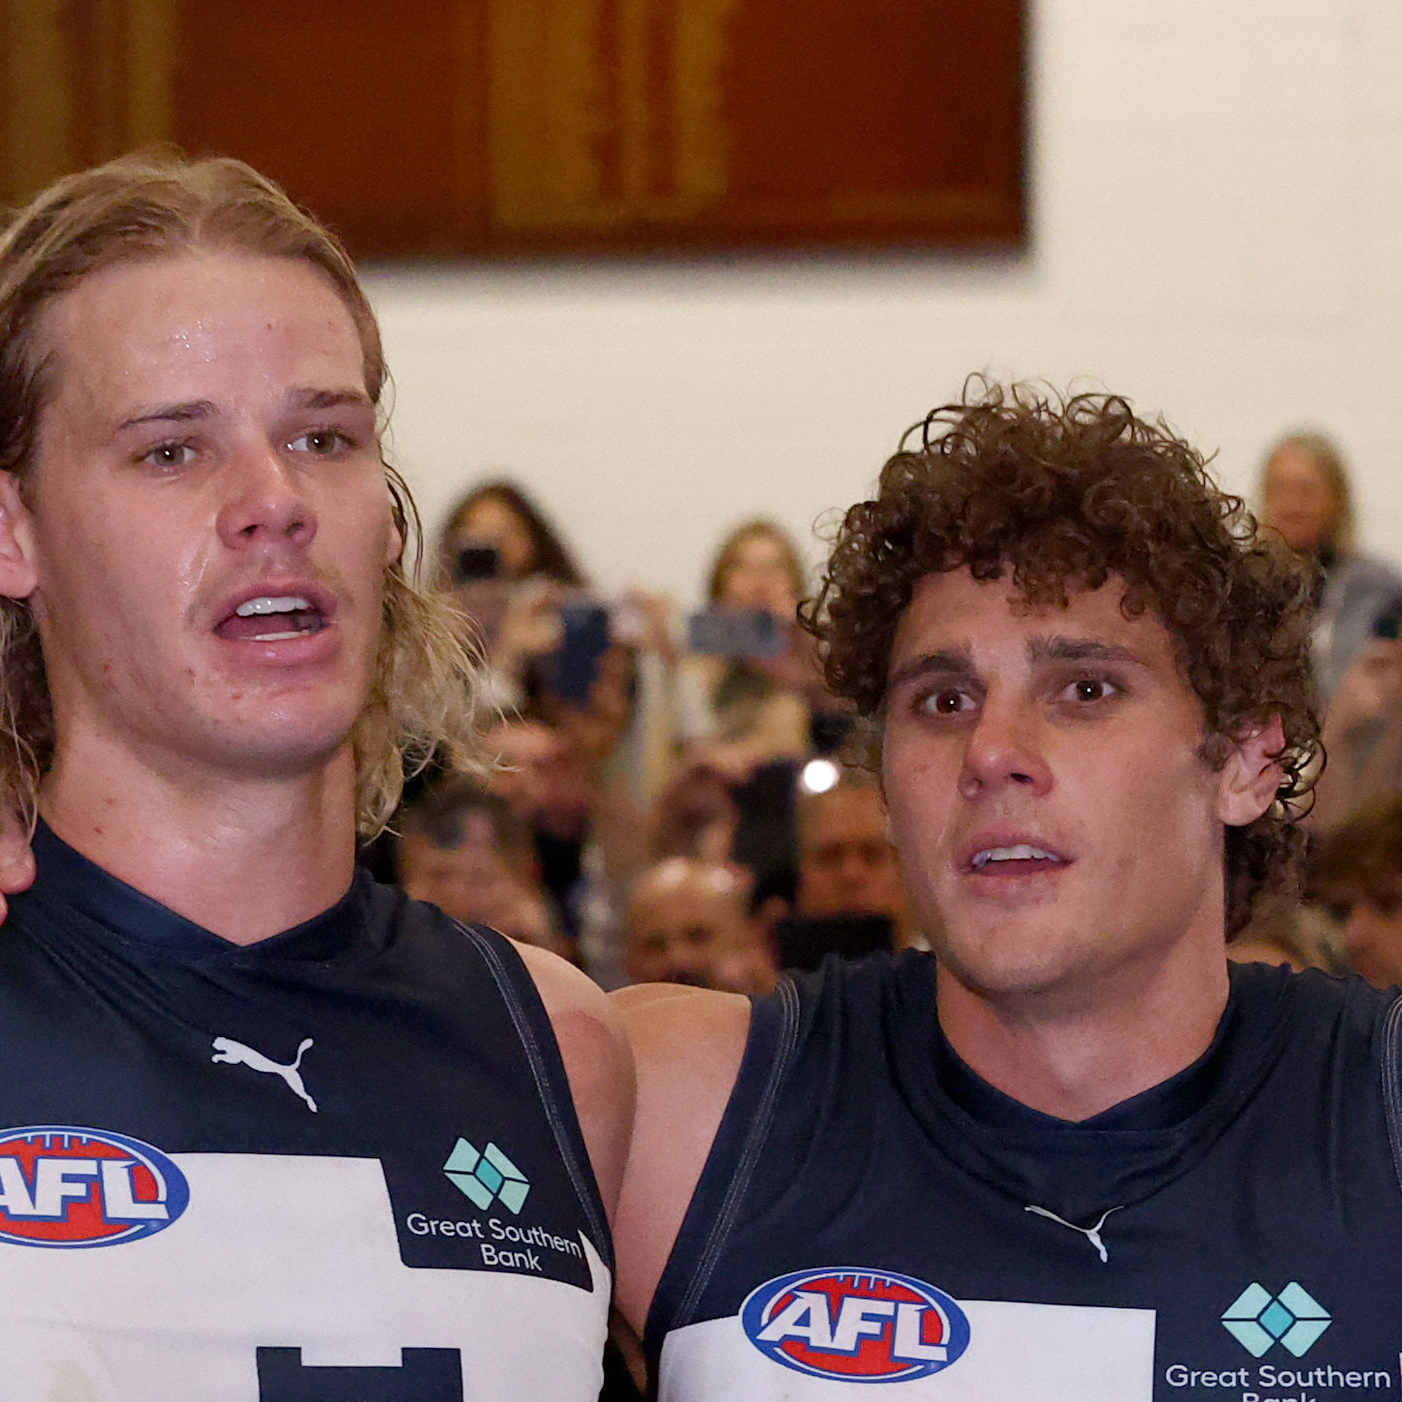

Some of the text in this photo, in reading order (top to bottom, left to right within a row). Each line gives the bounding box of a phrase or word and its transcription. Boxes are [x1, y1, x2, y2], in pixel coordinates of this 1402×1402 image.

[405, 1212, 583, 1260] Great Southern
[481, 1243, 543, 1273] Bank
[755, 1291, 949, 1362] AFL
[1164, 1364, 1392, 1390] Great Southern
